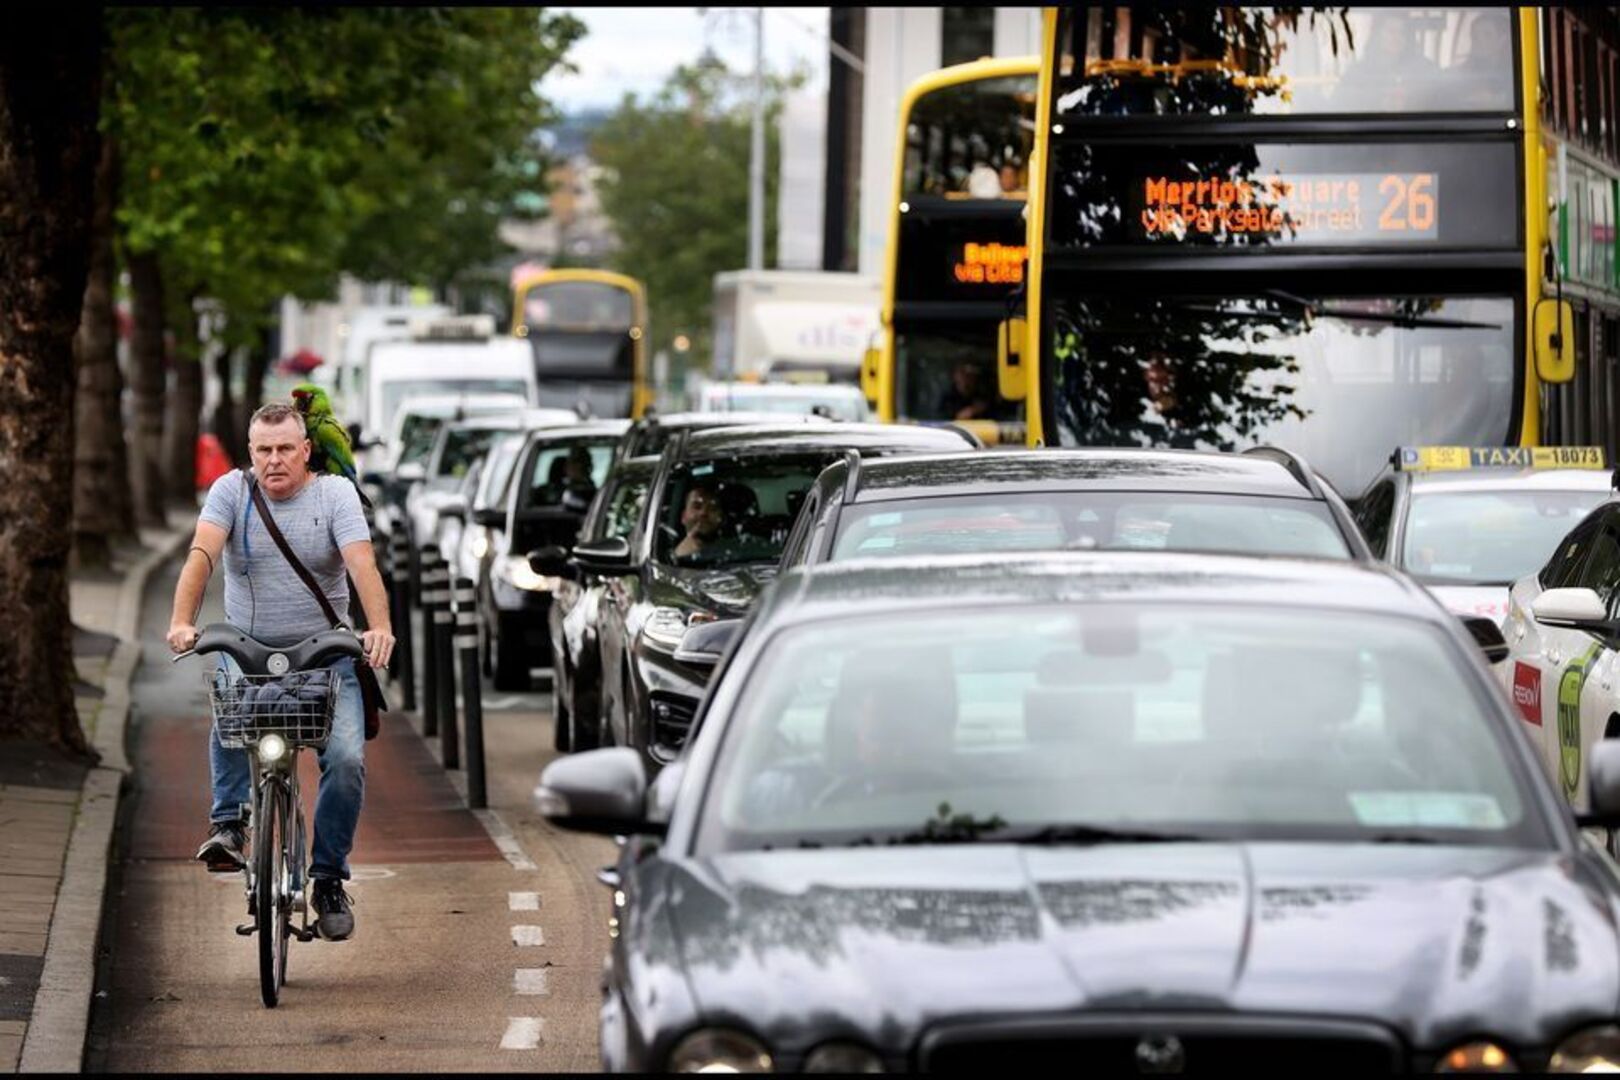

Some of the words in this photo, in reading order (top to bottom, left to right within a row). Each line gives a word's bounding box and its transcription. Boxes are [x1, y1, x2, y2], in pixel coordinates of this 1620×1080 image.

[1145, 176, 1255, 204] Merrion
[1378, 174, 1435, 231] 26
[1181, 203, 1283, 233] Parkgate
[1473, 448, 1530, 465] TAXI
[1552, 447, 1599, 465] 18073
